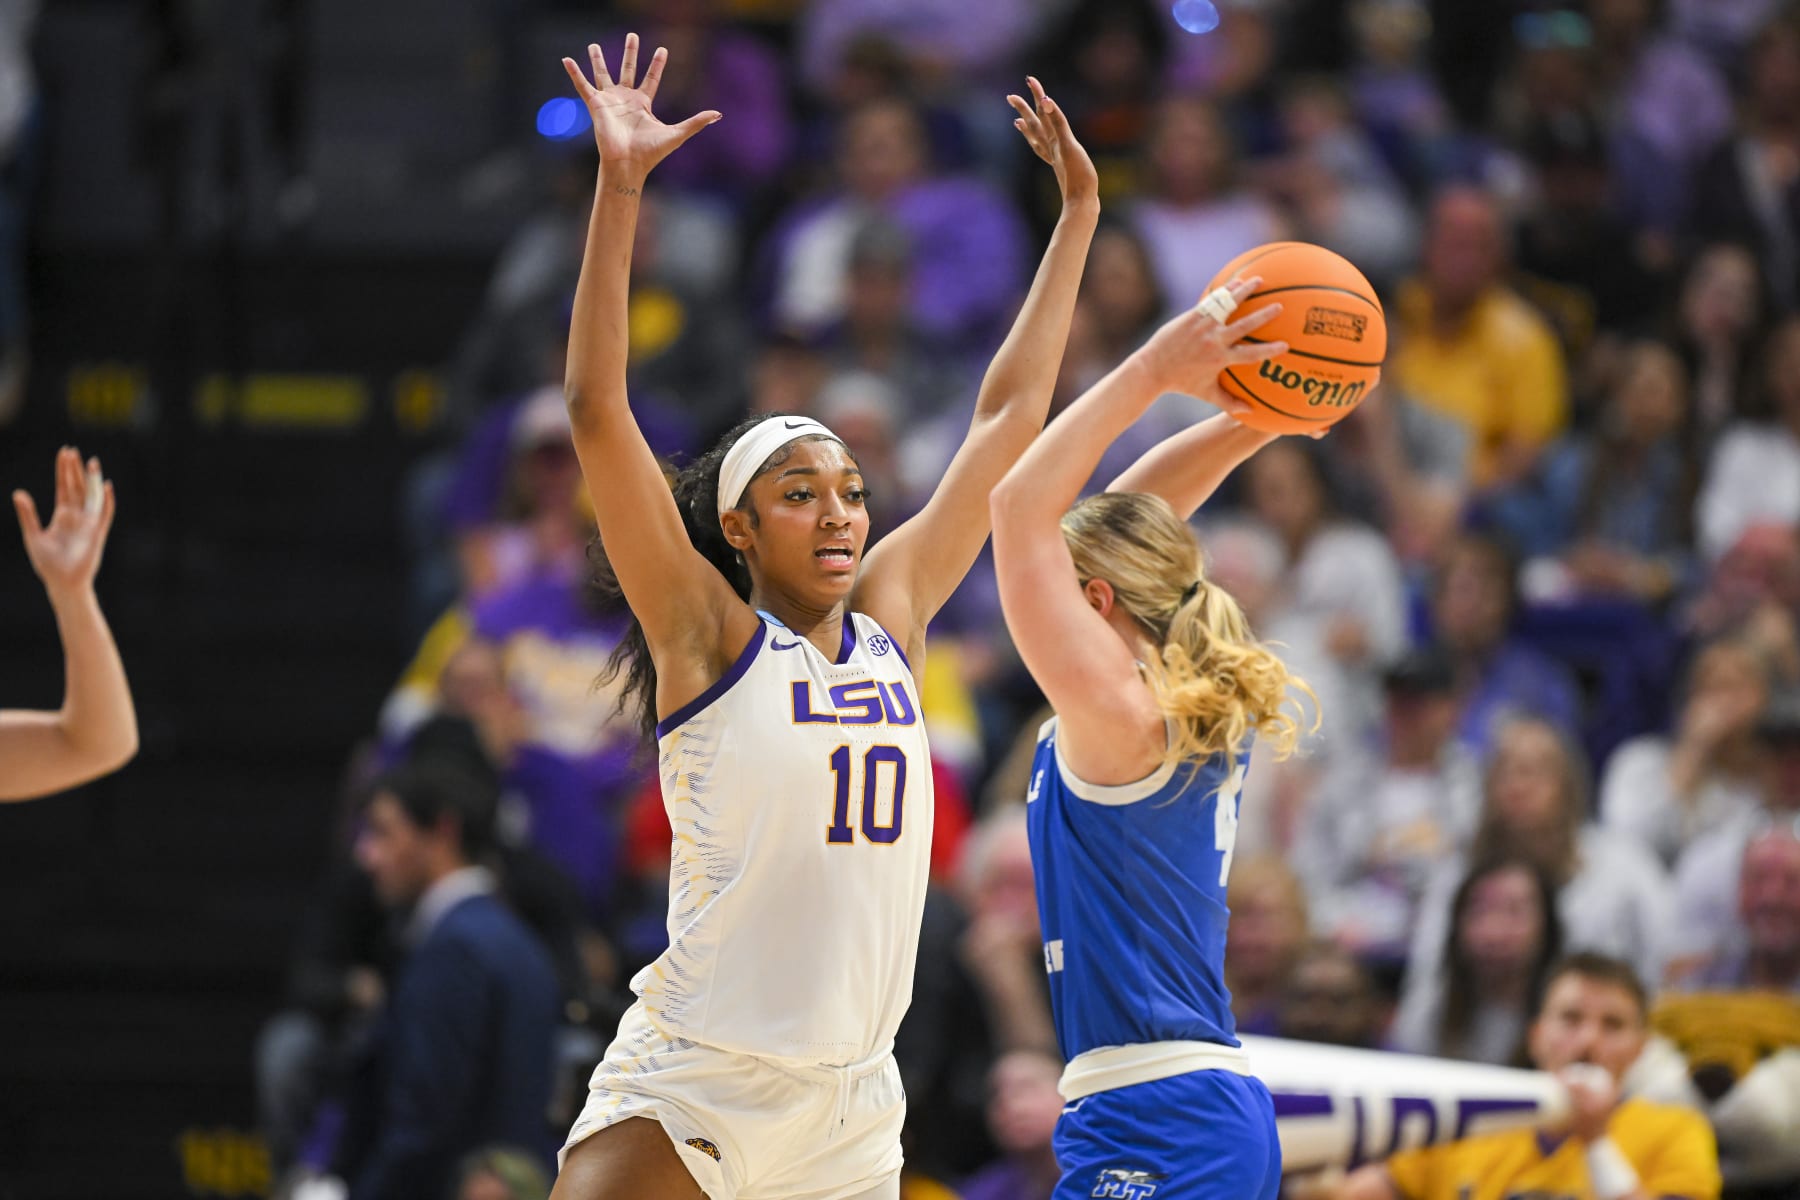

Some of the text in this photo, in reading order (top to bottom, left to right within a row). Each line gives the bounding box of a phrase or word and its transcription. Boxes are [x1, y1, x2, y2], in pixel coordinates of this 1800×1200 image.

[1259, 358, 1365, 407] Wilson
[867, 635, 889, 656] SEC
[790, 679, 916, 726] LSU
[826, 743, 907, 845] 10
